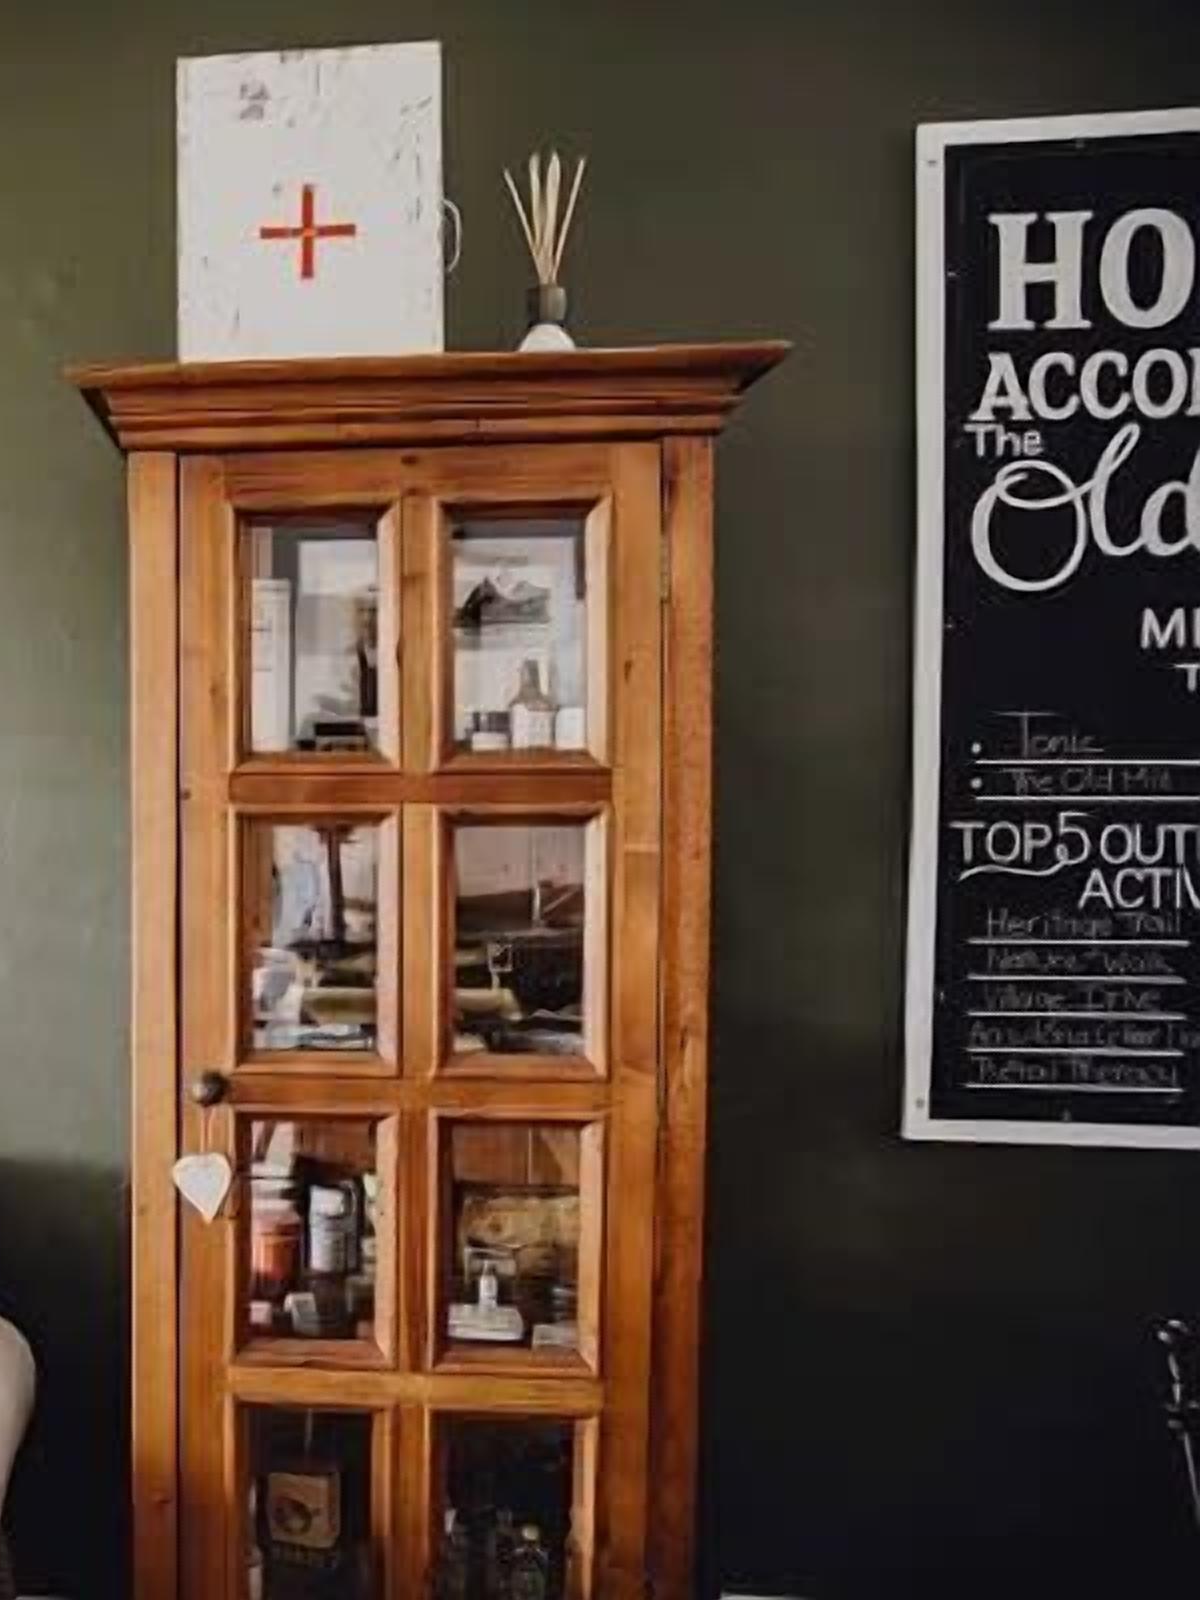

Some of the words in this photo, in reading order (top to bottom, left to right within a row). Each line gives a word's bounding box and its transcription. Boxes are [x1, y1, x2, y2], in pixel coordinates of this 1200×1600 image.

[987, 208, 1196, 330] HO
[969, 348, 1200, 421] ACCO
[963, 423, 1044, 457] The
[1100, 822, 1200, 865] OUT
